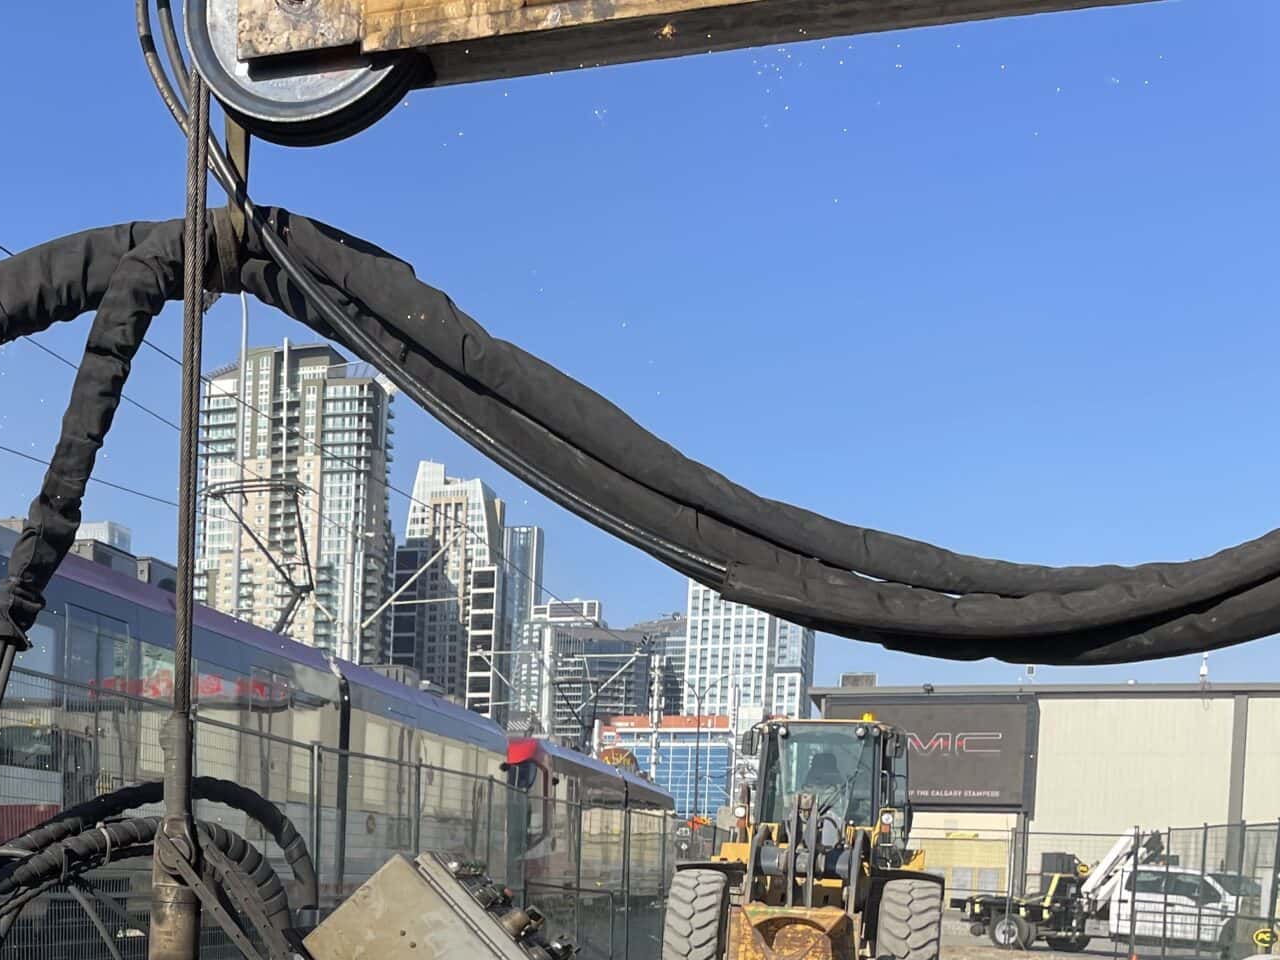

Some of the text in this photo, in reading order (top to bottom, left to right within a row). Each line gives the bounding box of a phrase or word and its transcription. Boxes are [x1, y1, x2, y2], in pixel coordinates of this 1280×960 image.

[904, 732, 1003, 757] MC
[931, 790, 962, 798] CALGARY
[1257, 932, 1271, 941] PC
